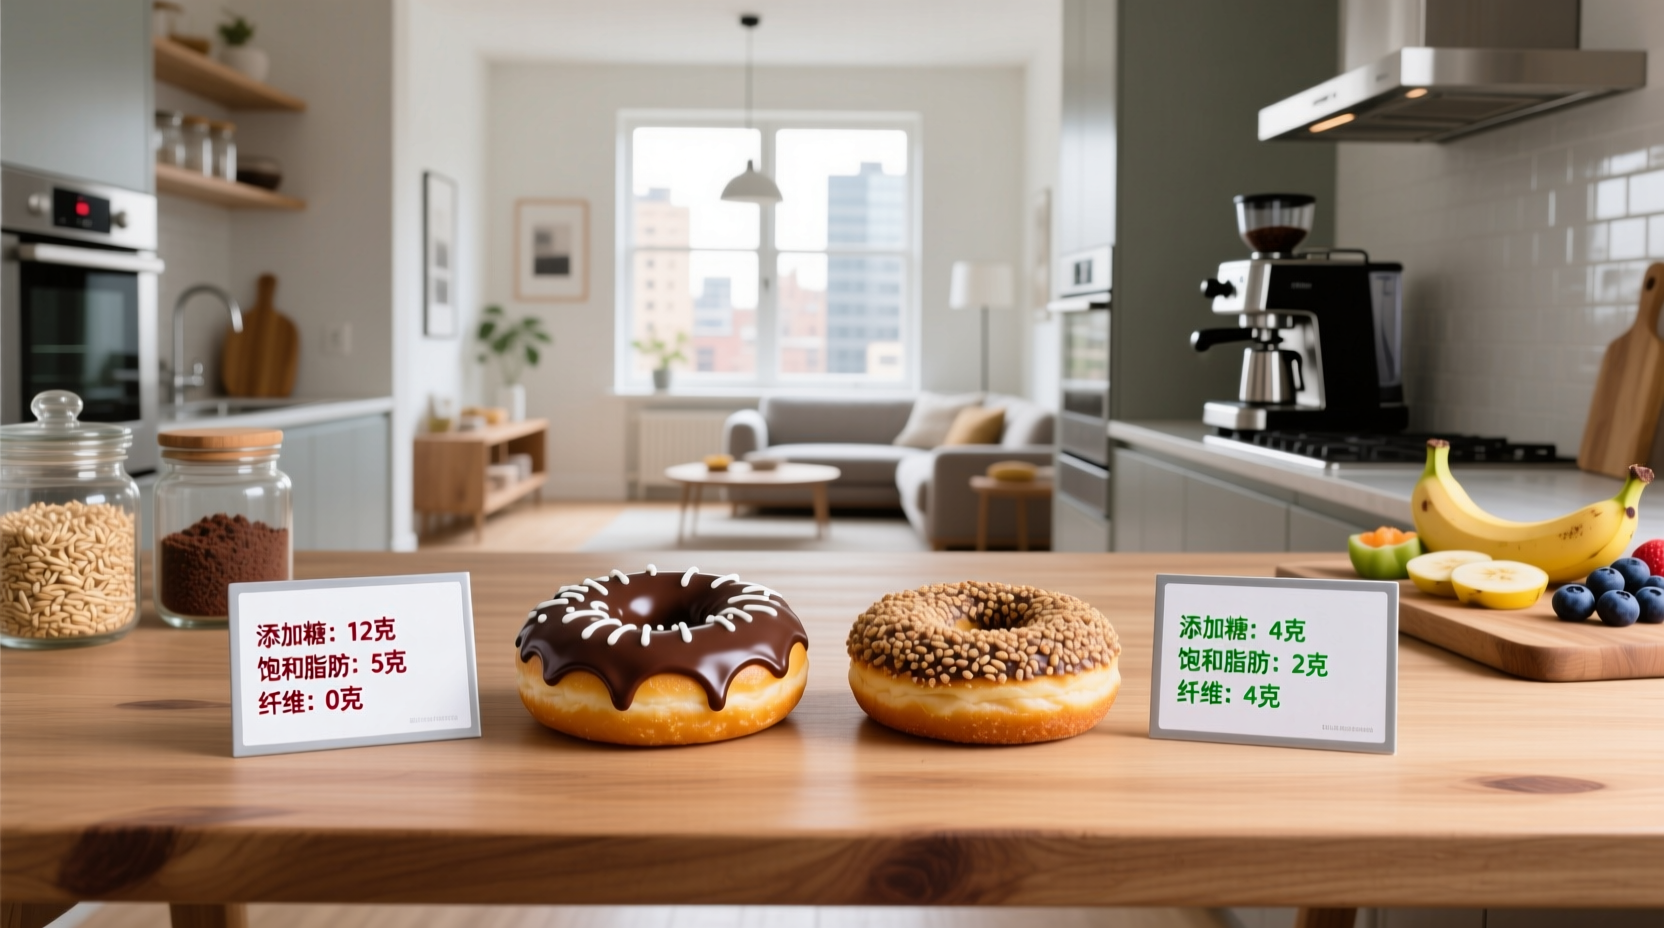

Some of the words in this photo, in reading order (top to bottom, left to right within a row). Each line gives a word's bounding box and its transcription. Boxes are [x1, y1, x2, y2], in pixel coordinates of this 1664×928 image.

[257, 616, 396, 648] 添加糖：12克
[1179, 614, 1306, 643] 添加糖：4克
[257, 648, 407, 681] 饱和脂肪：5克
[1178, 647, 1329, 677] 饱和脂肪：2克
[258, 685, 364, 715] 纤维：0克
[1177, 679, 1280, 708] 纤维：4克
